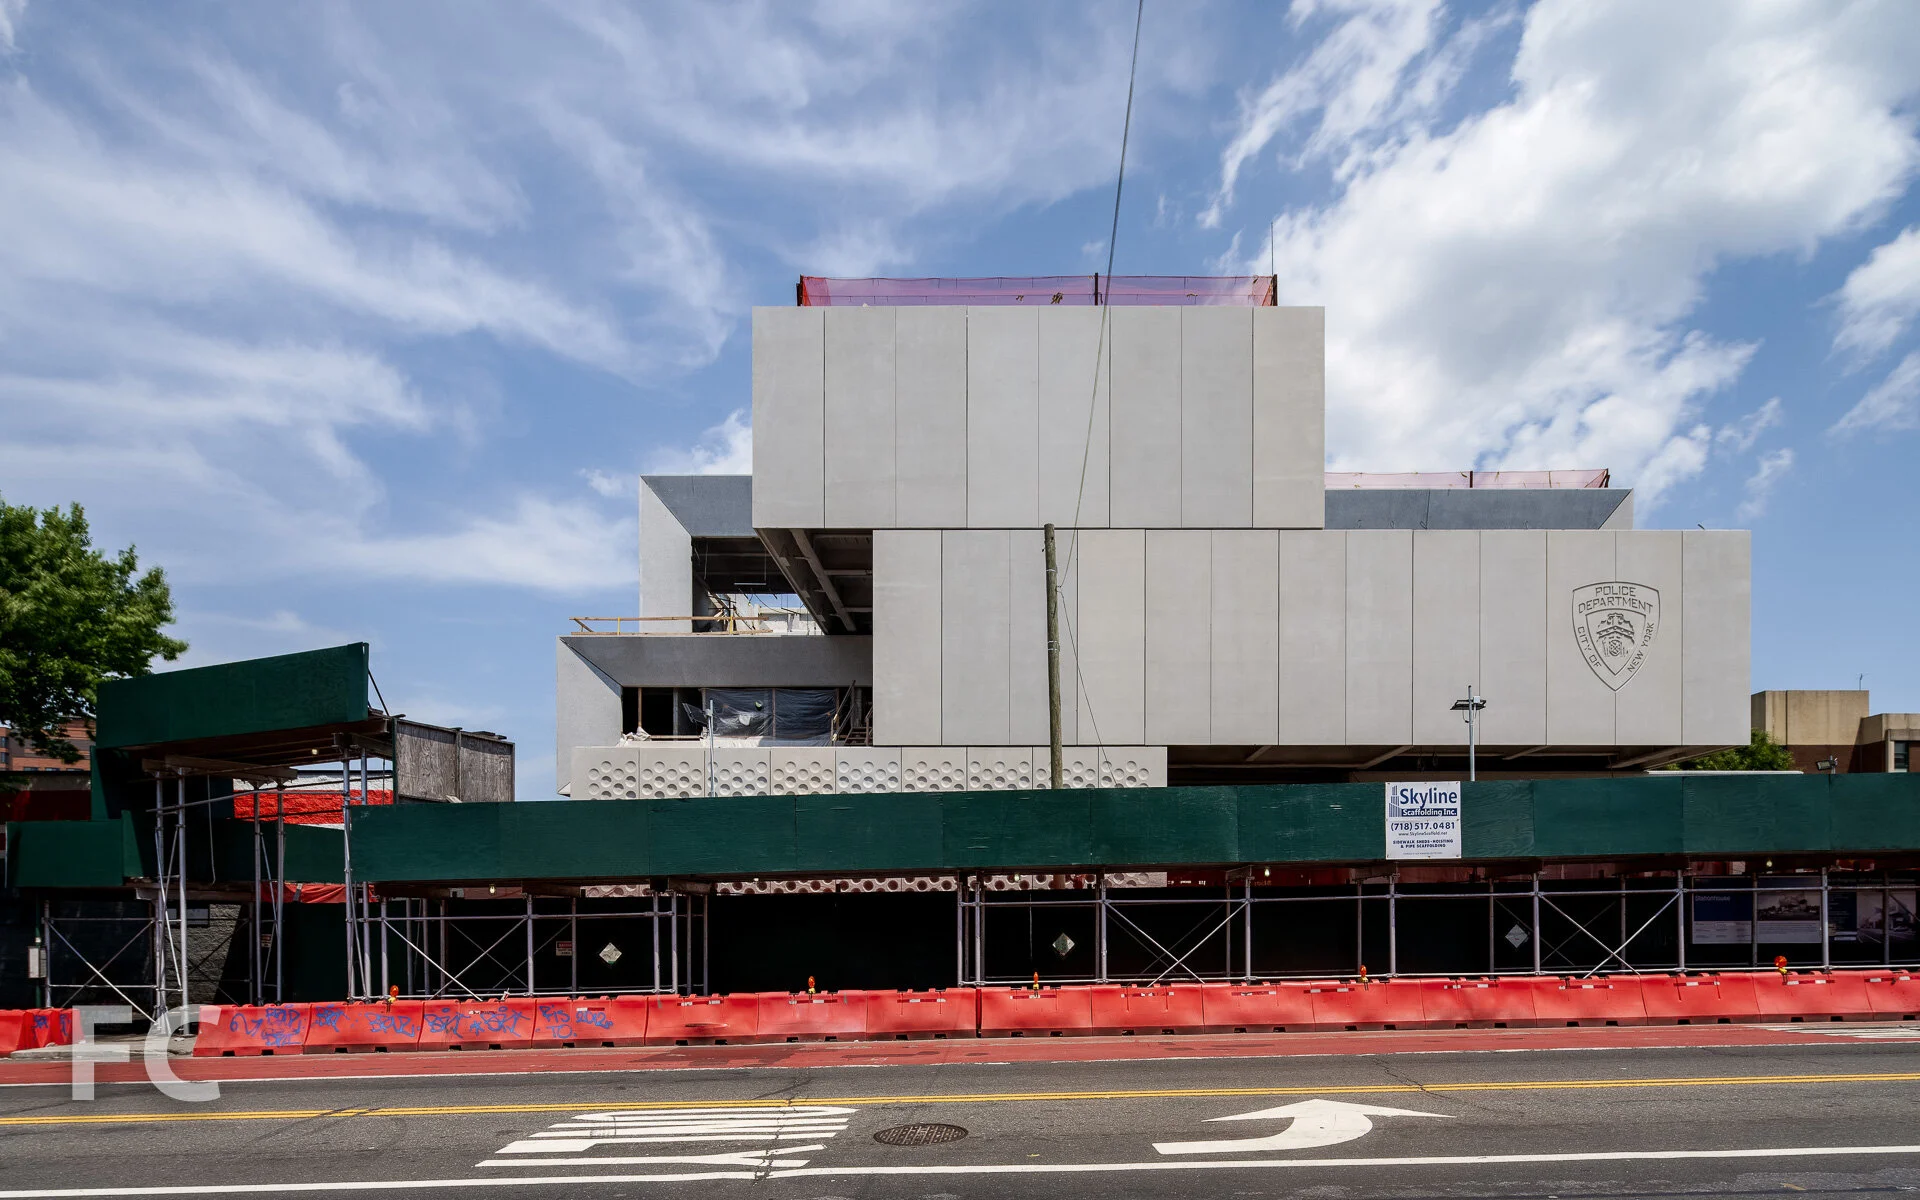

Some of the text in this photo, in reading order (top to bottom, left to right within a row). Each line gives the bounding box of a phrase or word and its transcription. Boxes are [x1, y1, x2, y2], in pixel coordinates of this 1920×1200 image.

[1595, 586, 1636, 597] POLICE
[1578, 596, 1654, 614] DEPARTMENT
[1577, 626, 1602, 668] CITY OF
[1627, 622, 1655, 673] NEW YORK
[1400, 788, 1458, 809] Skyline
[1402, 808, 1457, 817] Scaffolding Inc.
[1390, 821, 1455, 831] (718) 517.0481
